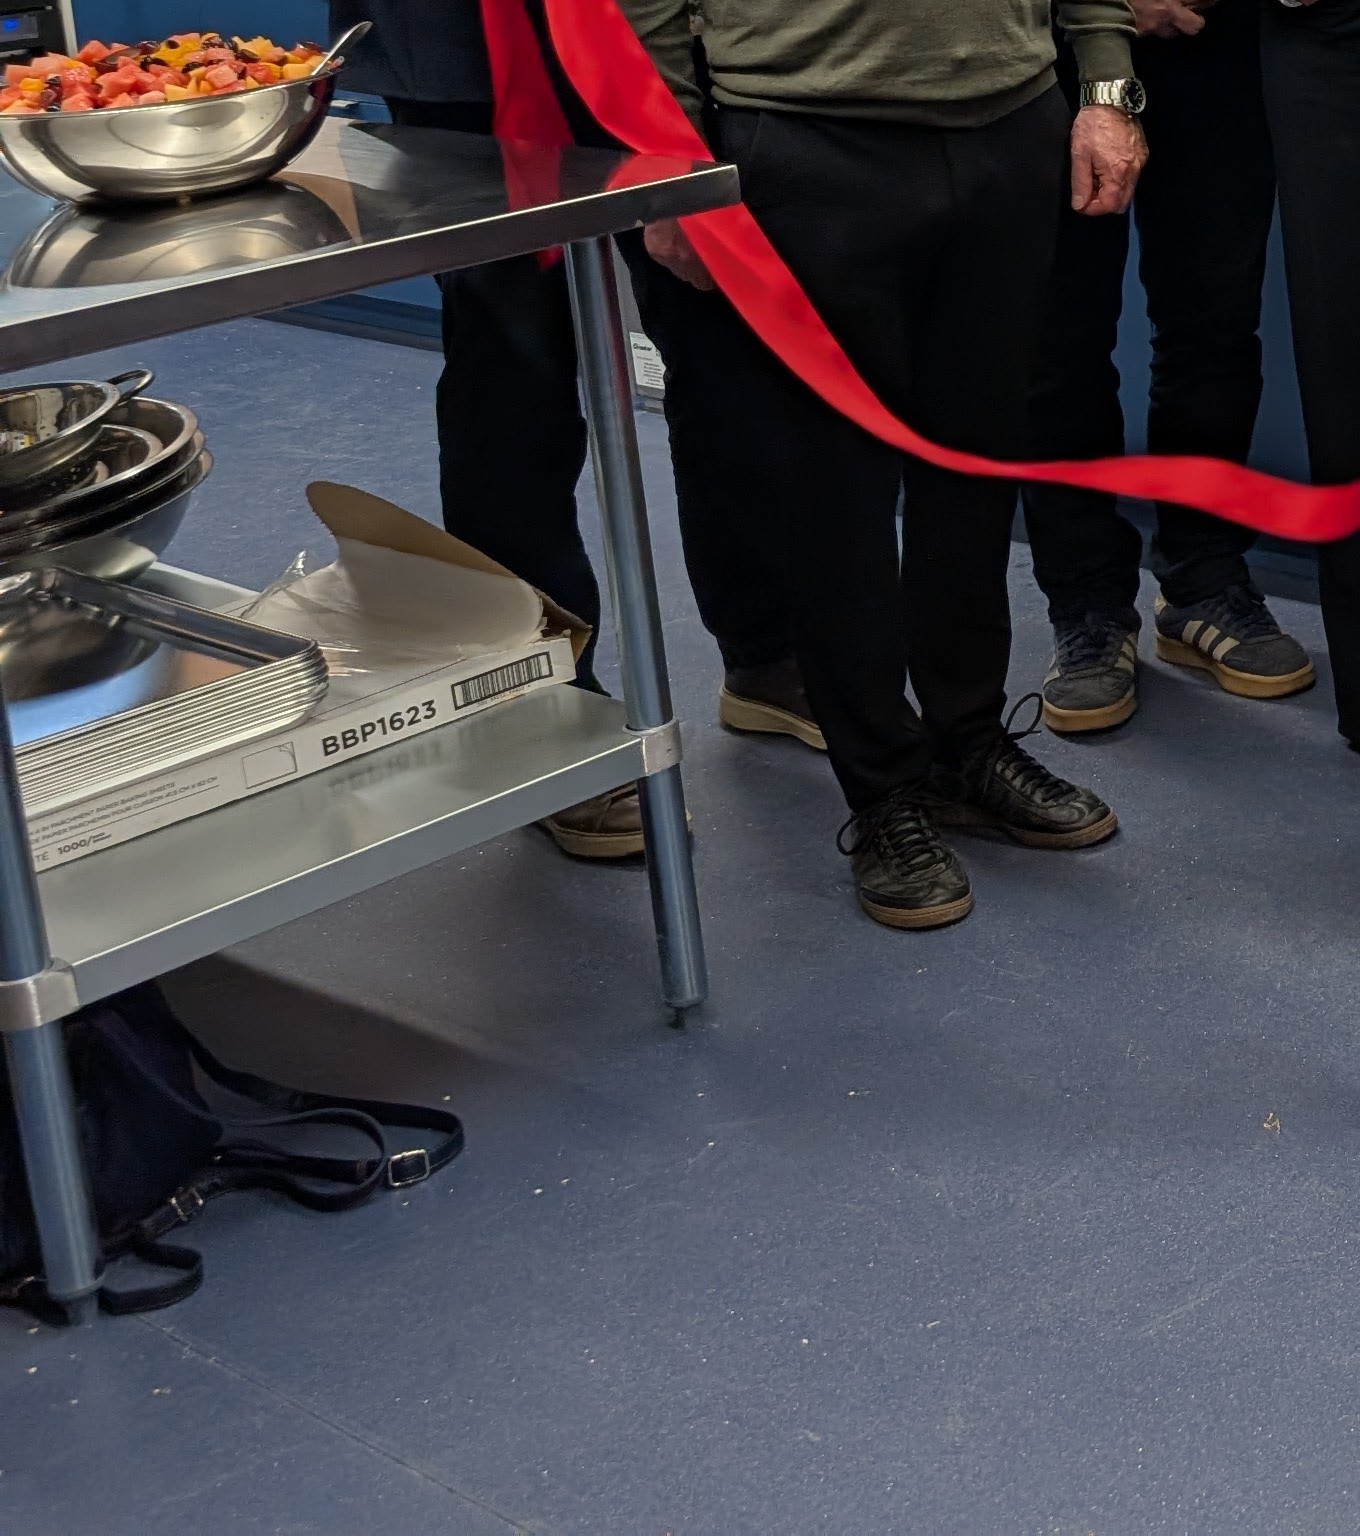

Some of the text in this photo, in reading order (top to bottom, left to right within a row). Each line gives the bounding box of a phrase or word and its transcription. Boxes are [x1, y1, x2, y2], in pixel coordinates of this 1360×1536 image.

[321, 699, 437, 757] BBP1623
[50, 809, 95, 828] PARCHMENT
[96, 801, 120, 813] PAPER
[120, 791, 148, 805] BAKING
[112, 805, 132, 817] POUR
[133, 794, 164, 809] CUISSON
[34, 850, 50, 862] TÉ
